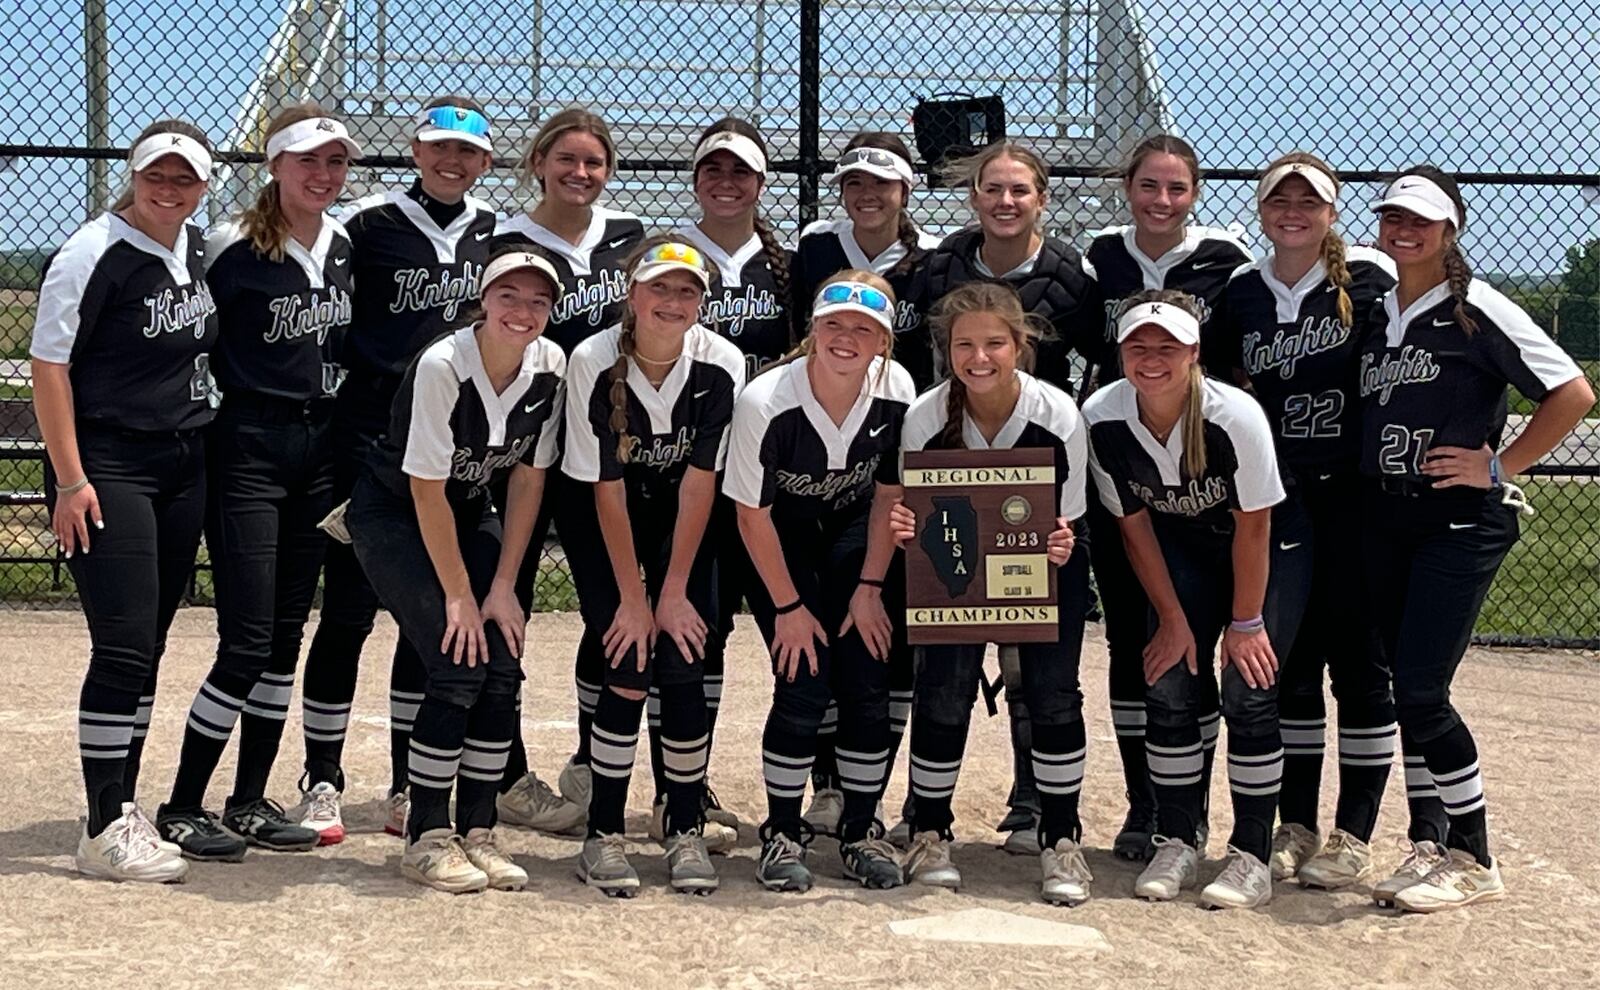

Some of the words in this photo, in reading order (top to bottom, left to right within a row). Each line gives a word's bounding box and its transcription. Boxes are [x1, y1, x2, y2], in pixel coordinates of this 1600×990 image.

[171, 135, 182, 147] K
[697, 283, 783, 337] nights
[1150, 304, 1162, 315] K
[1280, 389, 1345, 438] 22
[1379, 423, 1434, 475] 21
[922, 469, 1037, 484] REGIONAL
[995, 532, 1039, 547] 2023
[914, 610, 1049, 623] CHAMPIONS
